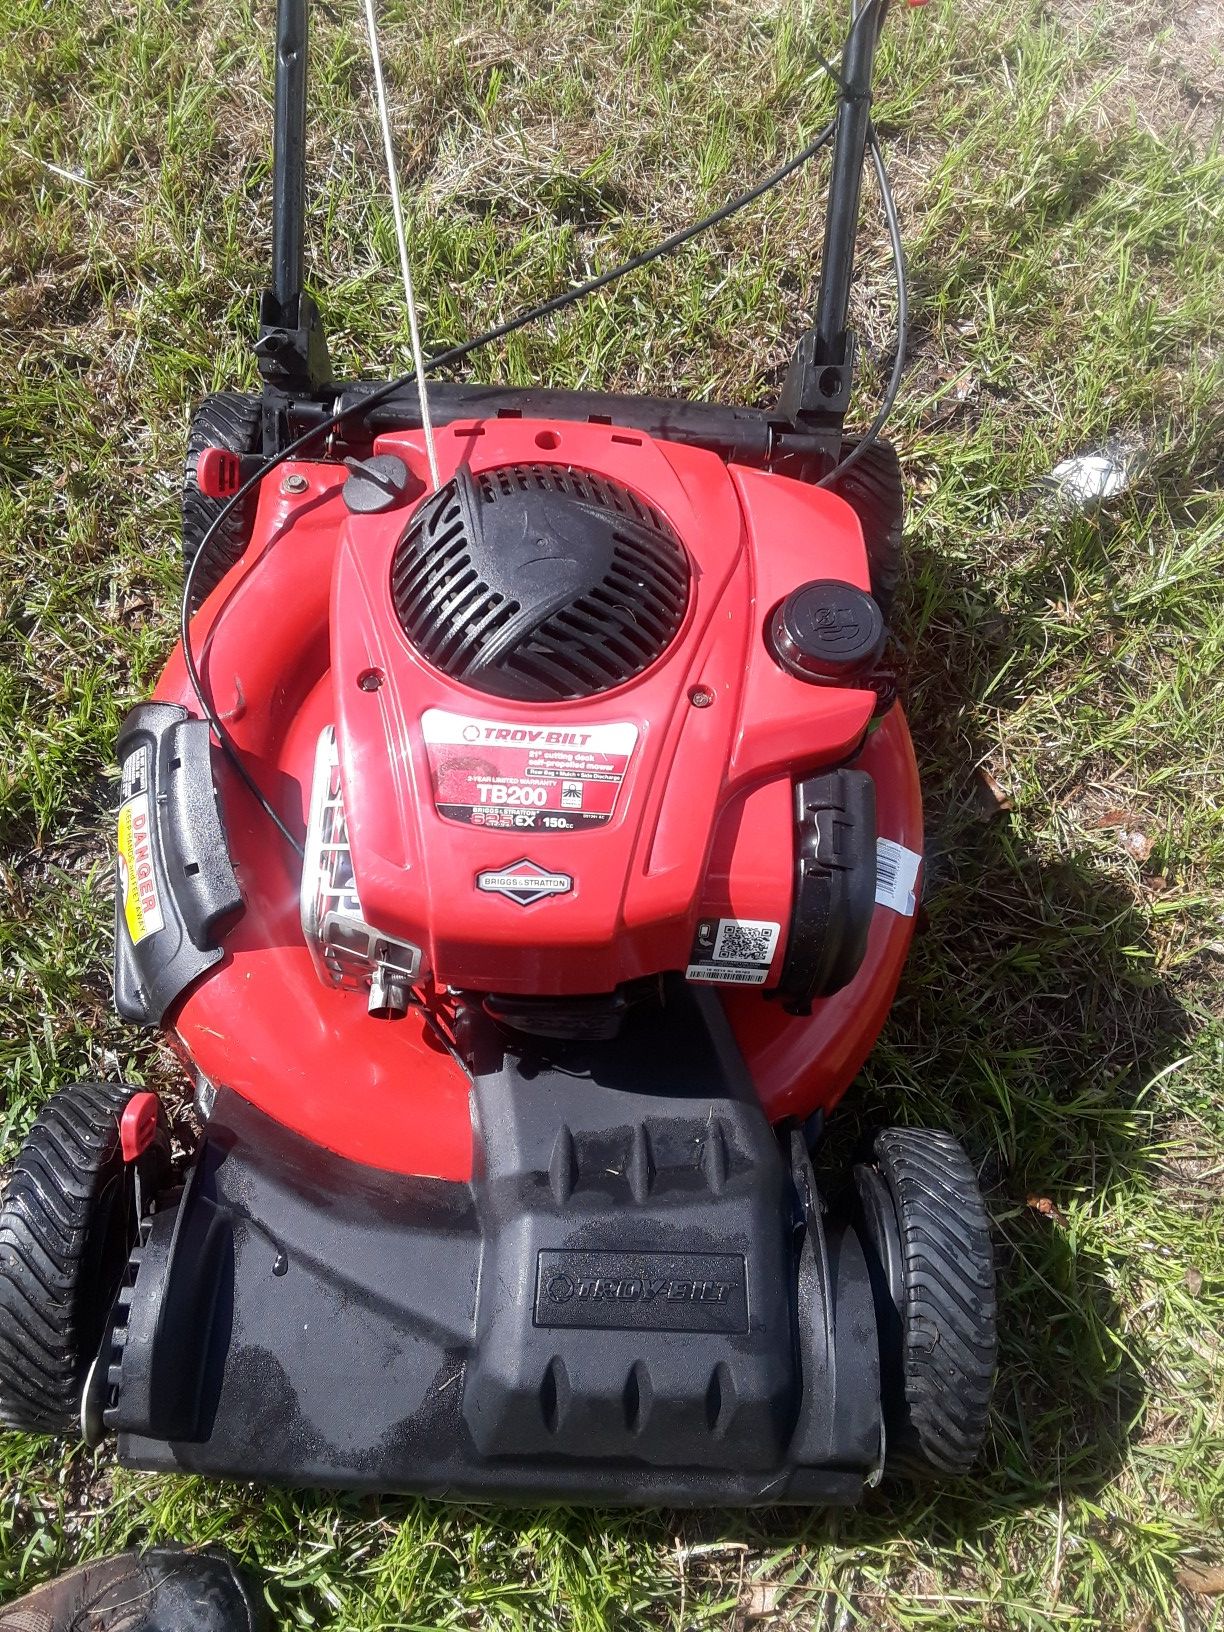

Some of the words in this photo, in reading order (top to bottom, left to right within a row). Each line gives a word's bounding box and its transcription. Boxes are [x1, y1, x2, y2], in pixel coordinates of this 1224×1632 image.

[484, 727, 592, 746] TROY-BILT
[528, 758, 585, 768] self-propelled
[544, 752, 573, 761] cutting
[575, 753, 595, 761] deck
[520, 778, 557, 786] WARRANTY
[593, 773, 621, 781] Discharge
[476, 783, 547, 806] TB200
[126, 833, 135, 864] HANDS
[132, 813, 157, 913] DANGER
[131, 882, 141, 903] FEET
[135, 905, 146, 932] AWAY
[577, 1276, 739, 1304] TROY-BILT
